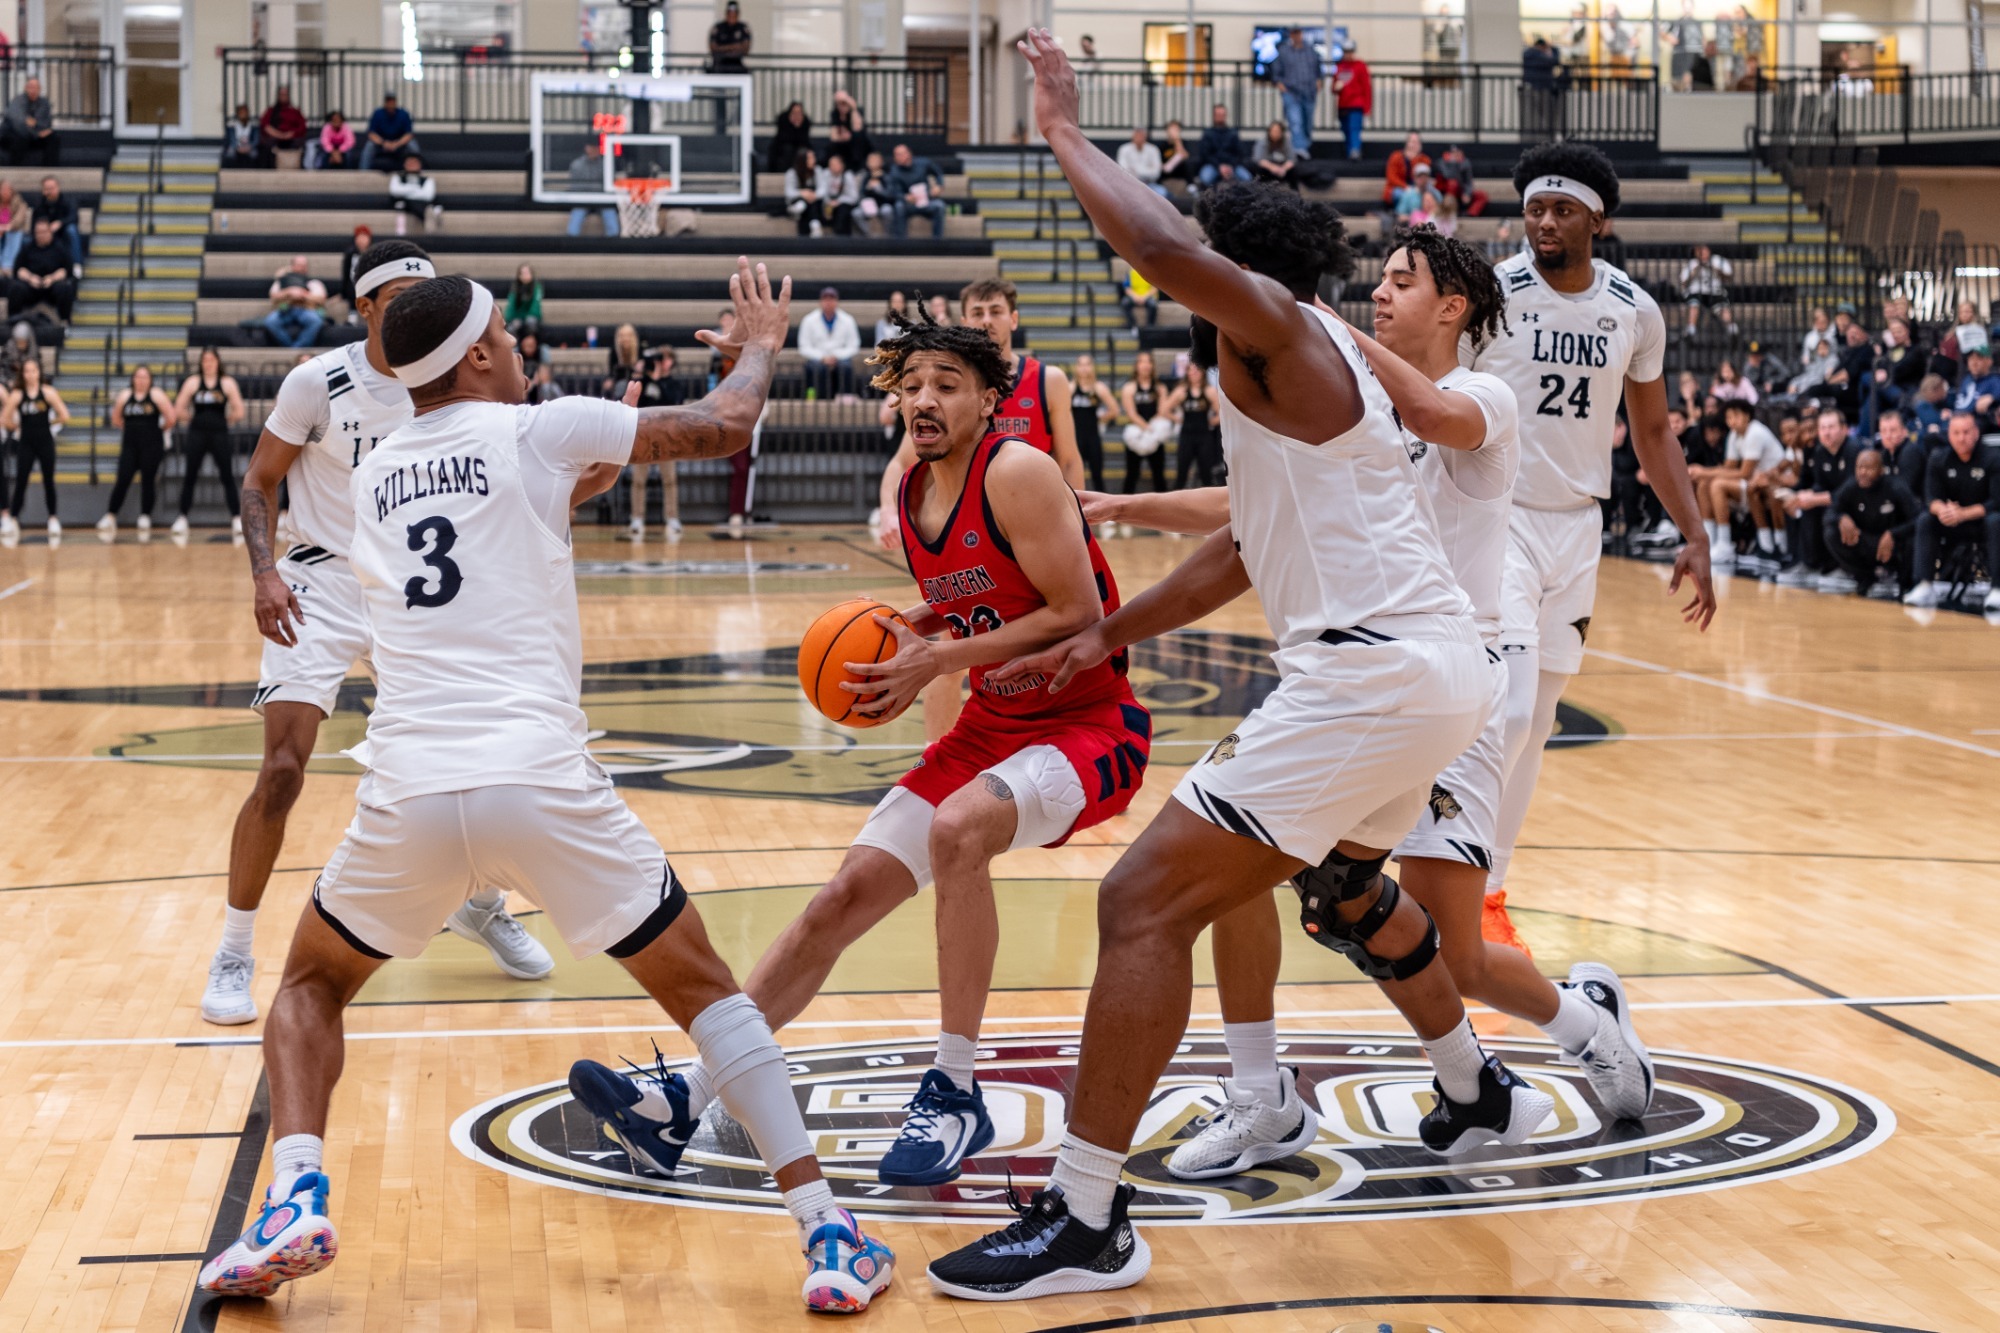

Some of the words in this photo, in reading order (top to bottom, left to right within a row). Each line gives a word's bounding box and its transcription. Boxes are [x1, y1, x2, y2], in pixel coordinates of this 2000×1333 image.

[1532, 329, 1608, 368] LIONS
[1536, 374, 1591, 419] 24
[374, 456, 490, 524] WILLIAMS
[404, 515, 464, 611] 3
[923, 564, 997, 604] SOUTHERN
